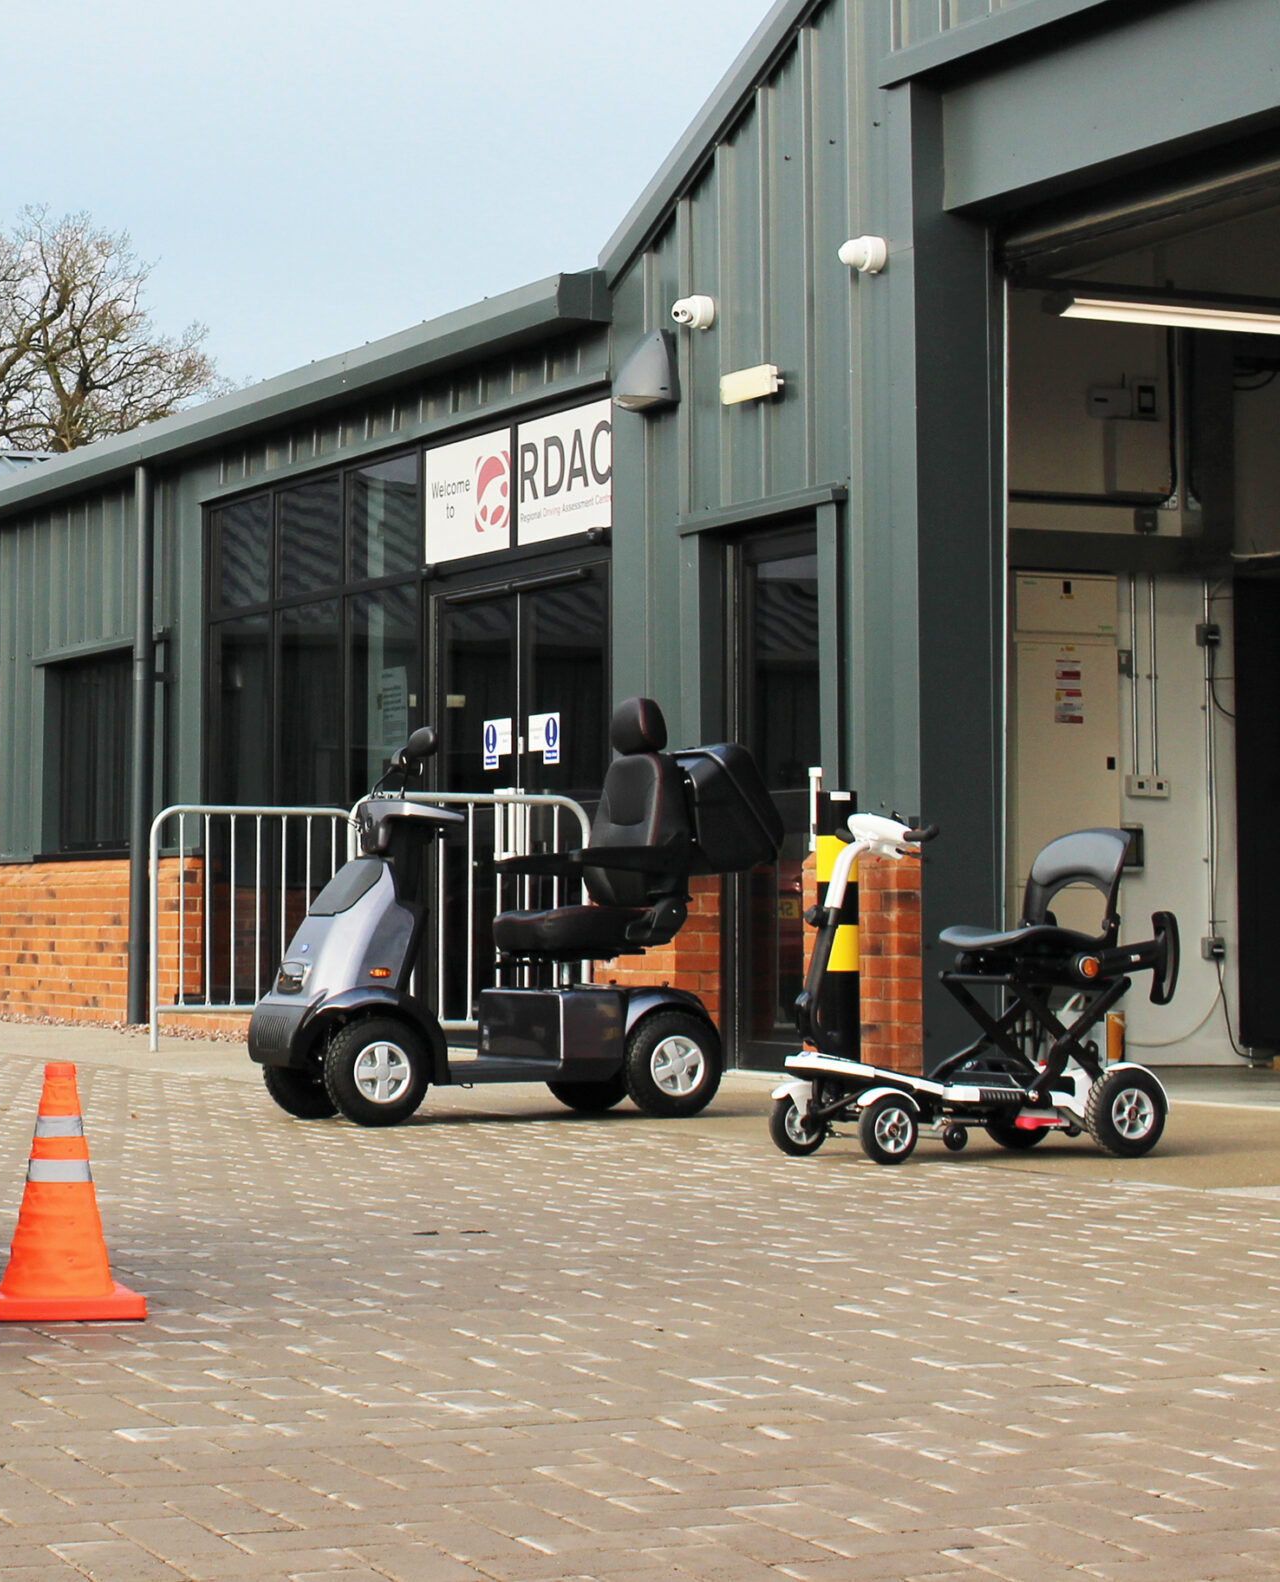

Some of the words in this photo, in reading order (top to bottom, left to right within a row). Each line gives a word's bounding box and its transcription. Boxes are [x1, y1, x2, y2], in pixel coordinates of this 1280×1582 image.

[521, 420, 611, 503] RDAC
[431, 479, 470, 499] Welcome
[446, 503, 455, 519] to
[520, 511, 541, 523] Regional
[543, 507, 560, 517] Driving
[562, 498, 593, 512] Assessment
